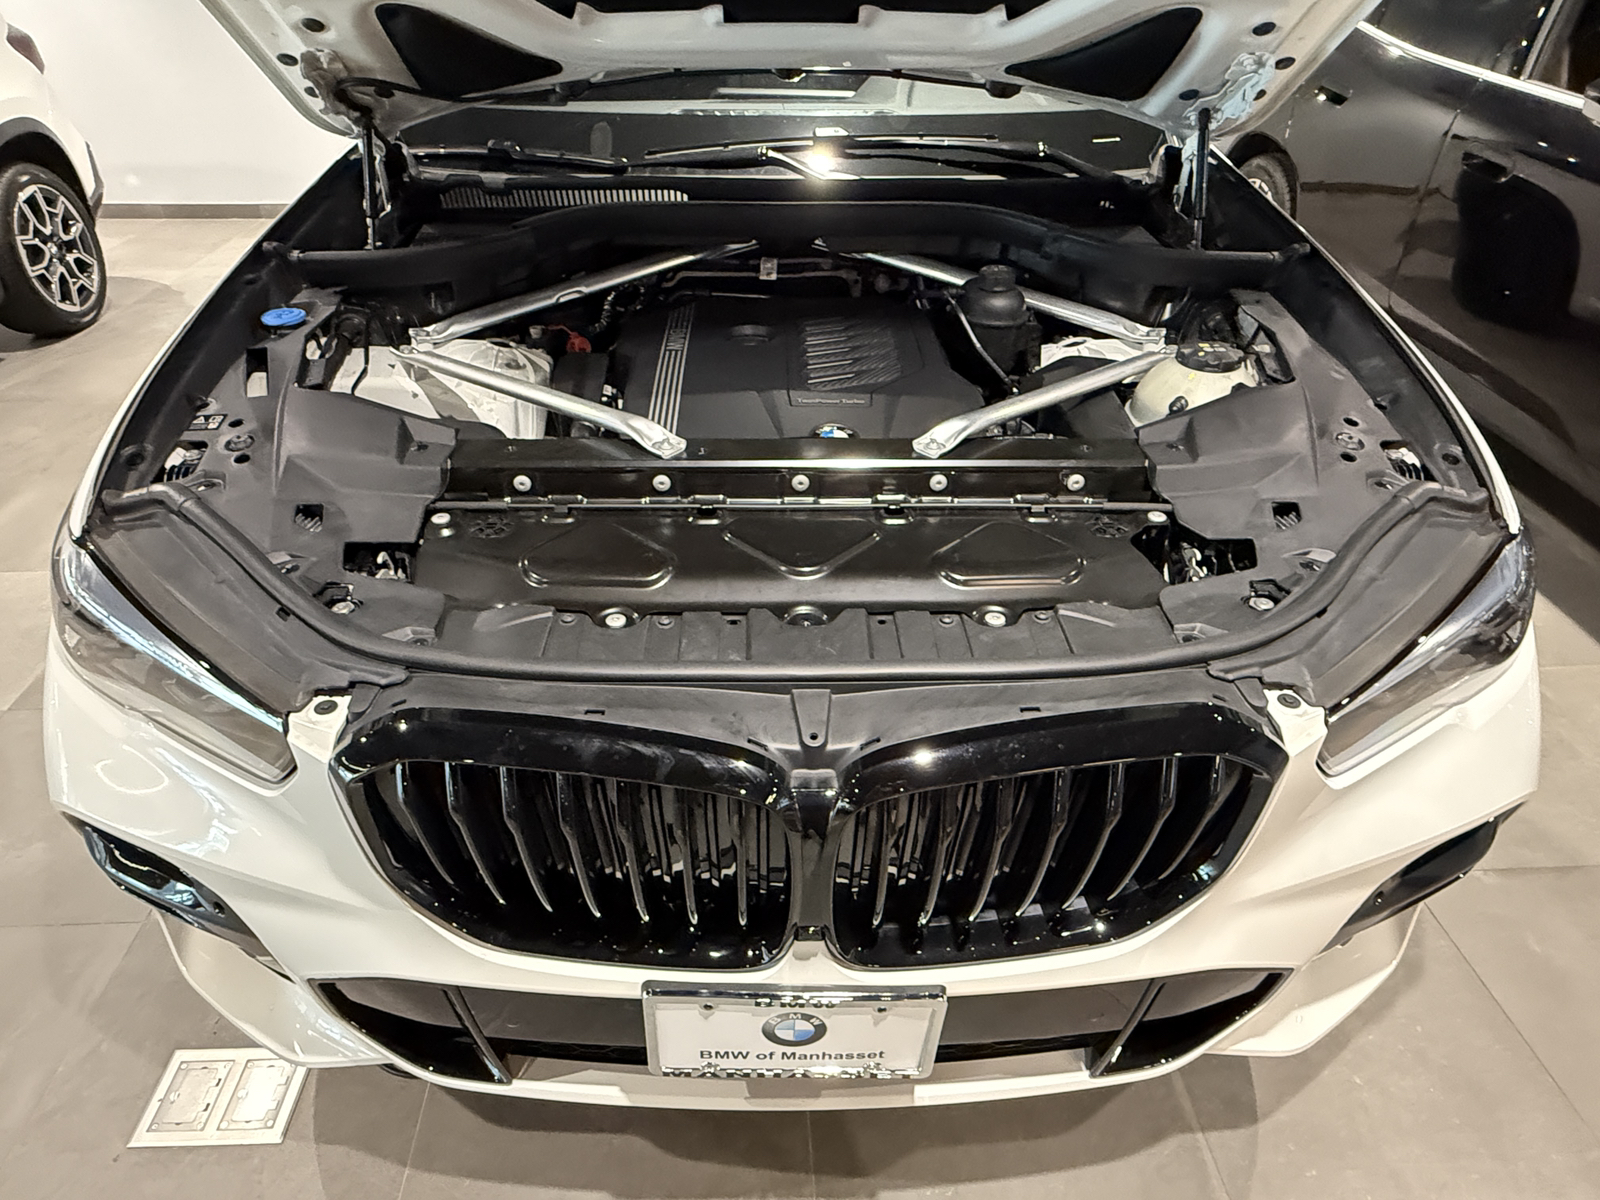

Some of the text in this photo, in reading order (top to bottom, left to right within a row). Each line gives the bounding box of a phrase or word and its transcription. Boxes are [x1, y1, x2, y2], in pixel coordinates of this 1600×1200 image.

[666, 329, 686, 350] BMW
[768, 1013, 823, 1026] BMW
[700, 1050, 886, 1061] BMW of Manhasset
